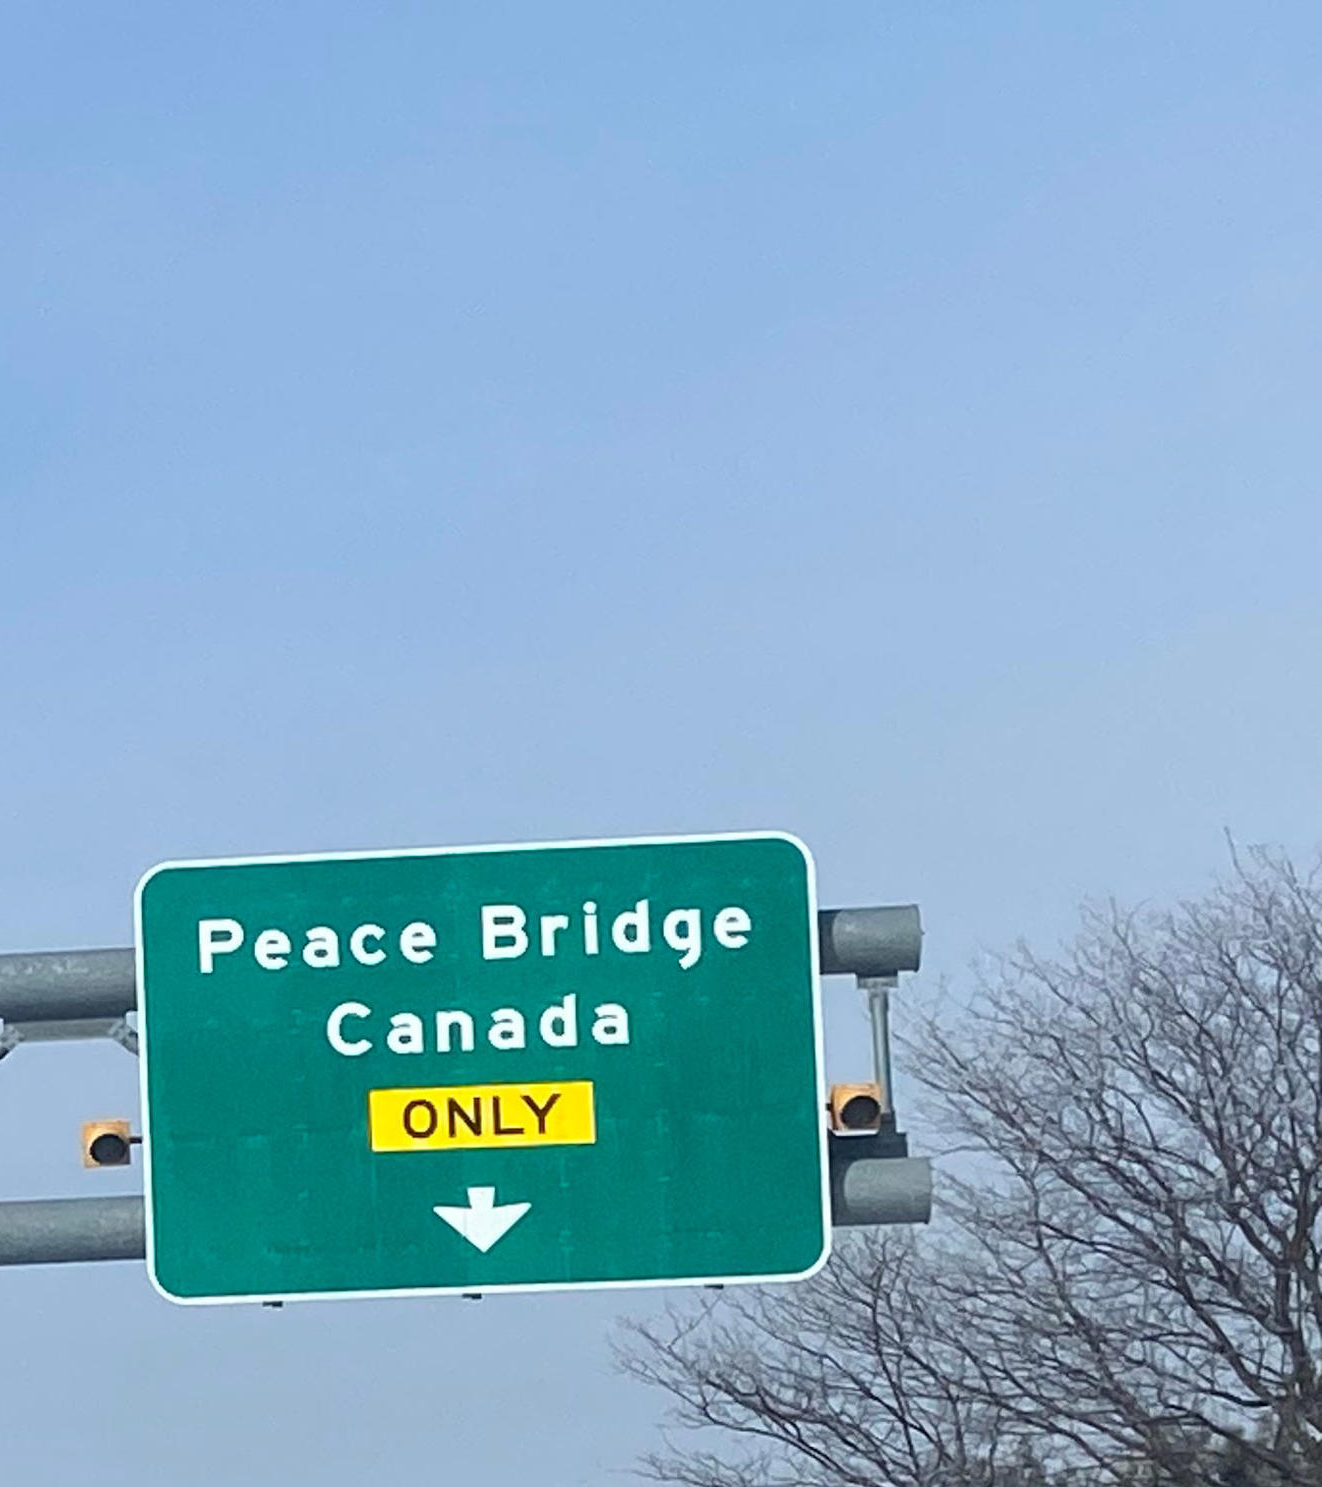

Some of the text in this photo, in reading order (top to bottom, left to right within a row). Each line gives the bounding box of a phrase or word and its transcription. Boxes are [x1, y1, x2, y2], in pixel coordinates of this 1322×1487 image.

[197, 898, 753, 974] Peace Bridge
[326, 994, 630, 1057] Canada
[402, 1093, 562, 1140] ONLY
